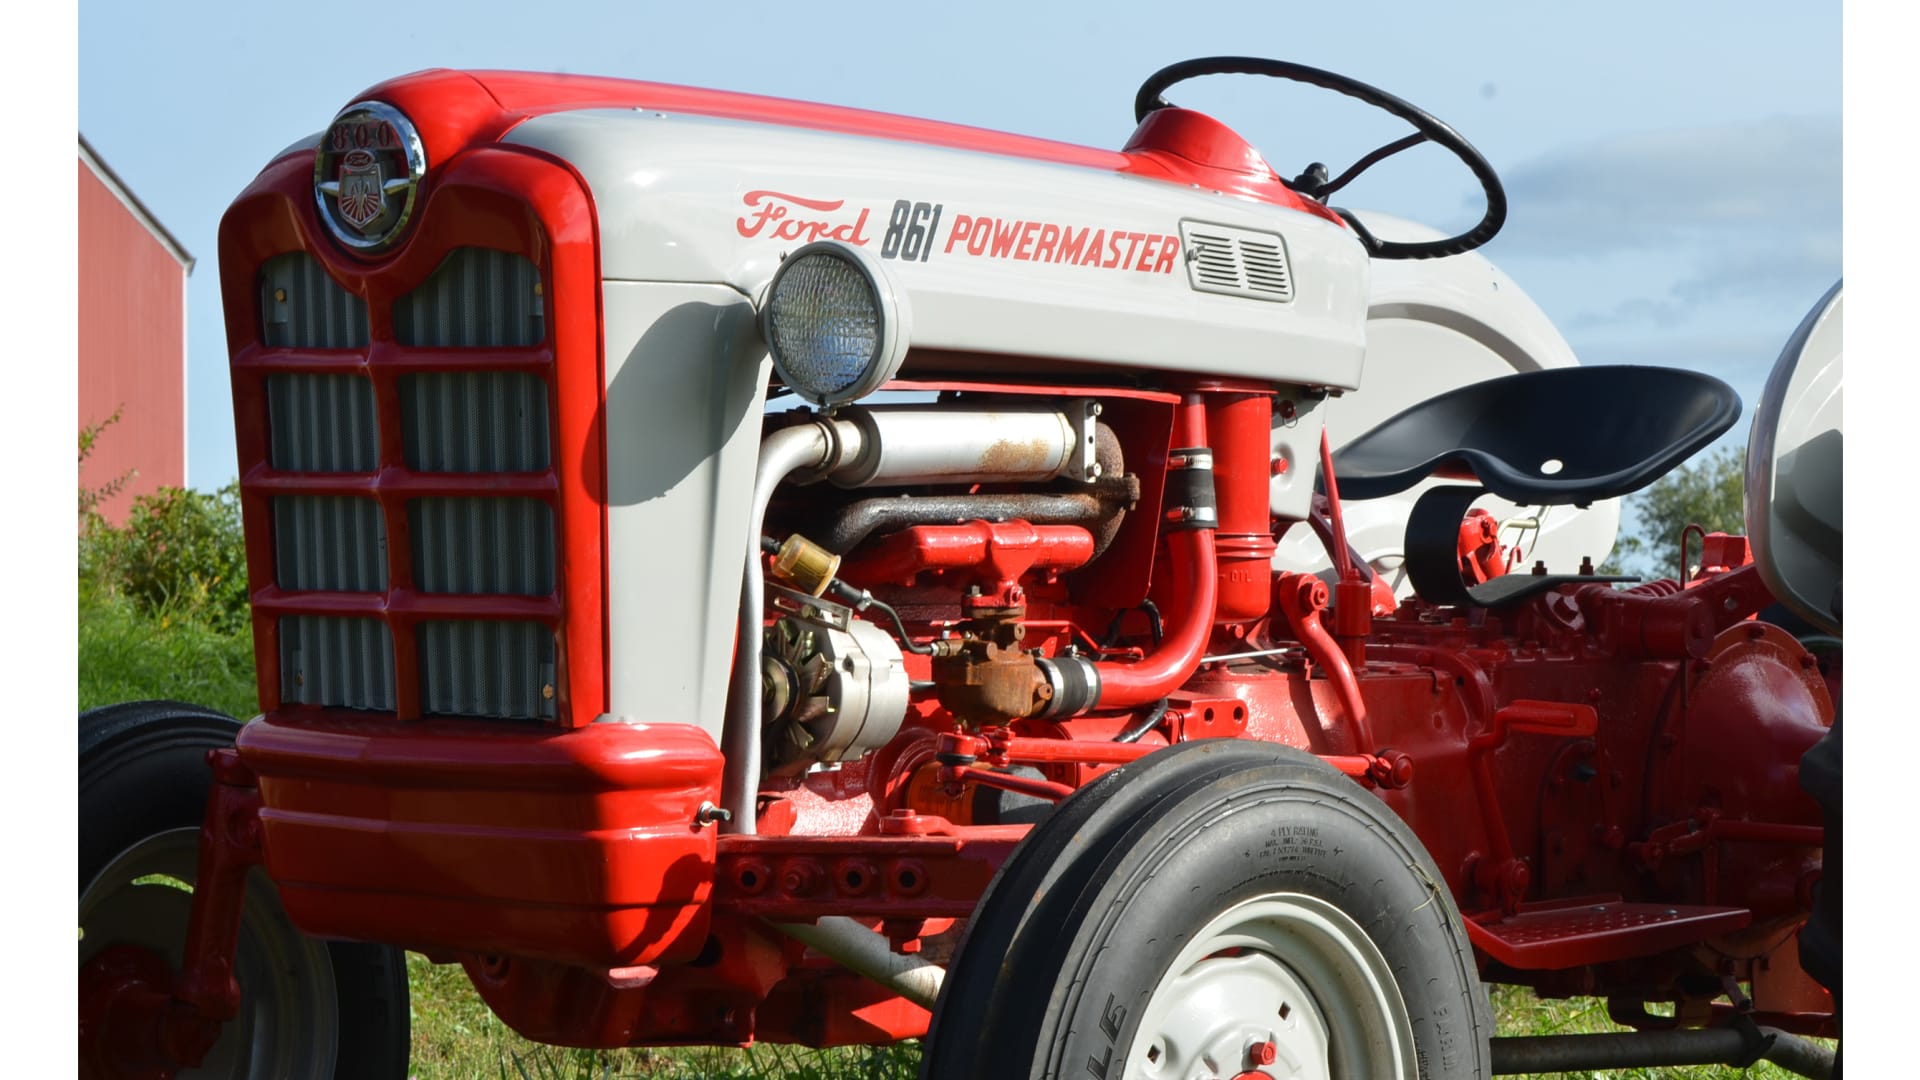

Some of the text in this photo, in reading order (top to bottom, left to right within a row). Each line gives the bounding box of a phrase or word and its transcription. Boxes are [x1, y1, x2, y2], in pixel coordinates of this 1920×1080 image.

[333, 120, 391, 149] 800
[736, 190, 1180, 274] Ford 861 POWERMASTER
